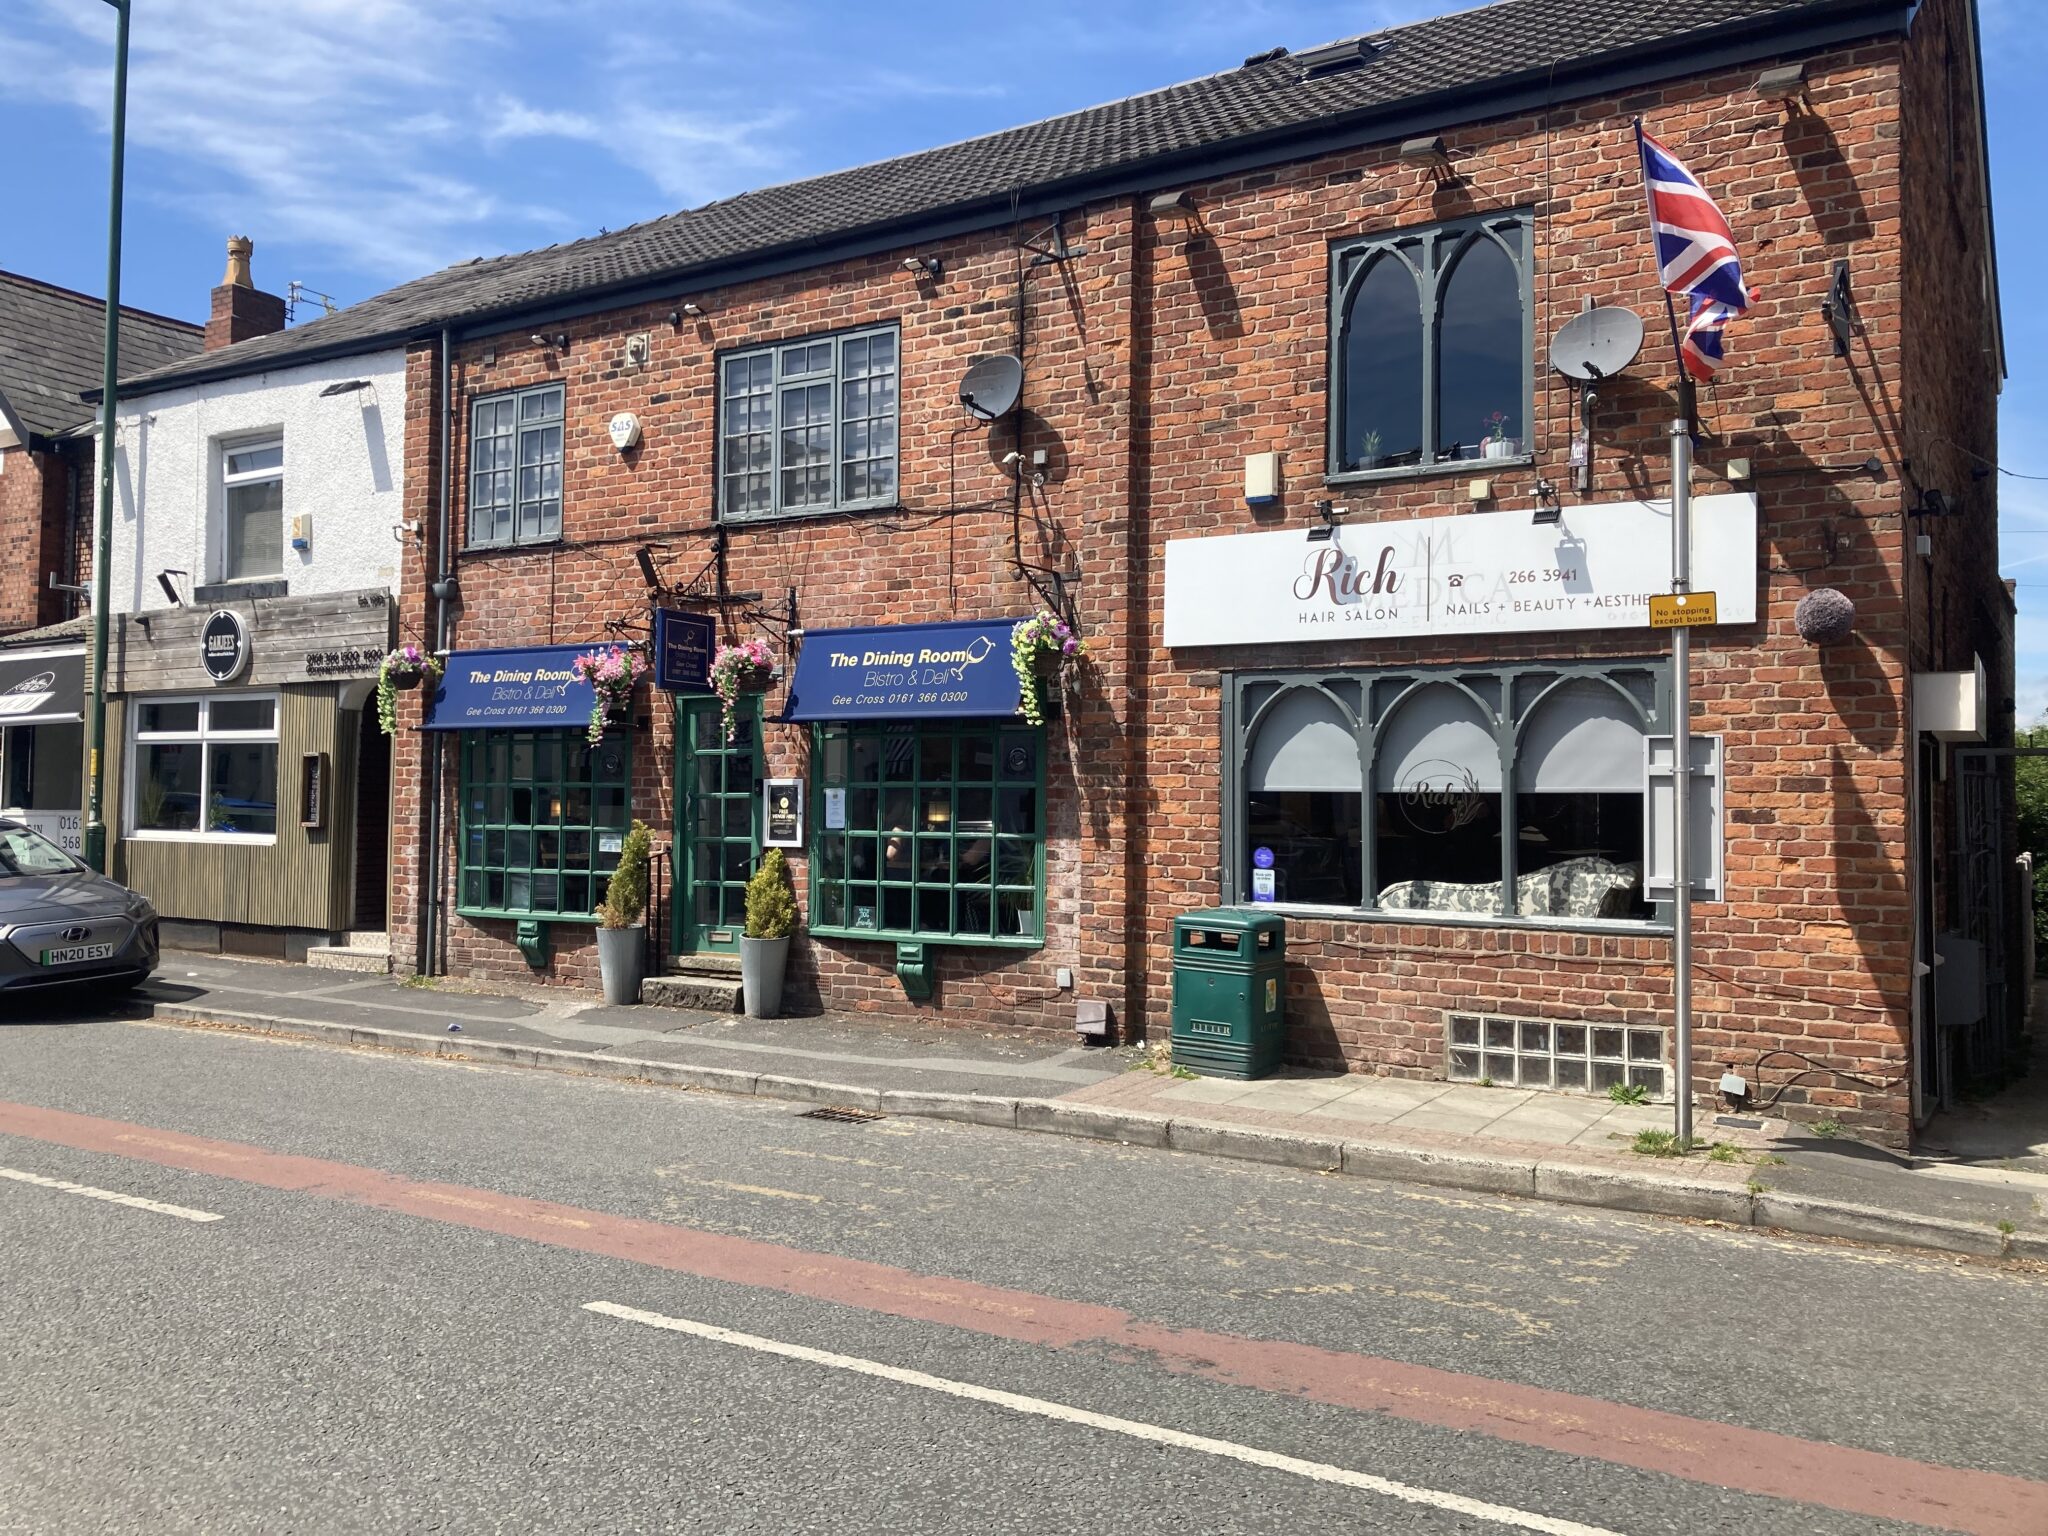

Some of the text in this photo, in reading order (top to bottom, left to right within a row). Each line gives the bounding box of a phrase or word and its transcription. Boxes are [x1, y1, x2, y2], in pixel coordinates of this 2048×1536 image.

[1293, 546, 1405, 605] Rich
[1508, 568, 1577, 584] 266 3941
[1446, 602, 1490, 616] NAILS
[1514, 598, 1577, 613] BEAUTY
[1673, 607, 1710, 616] stopping
[1299, 608, 1398, 624] HAIR SALON
[1654, 615, 1712, 625] except buses
[830, 649, 968, 668] The Dining Room
[469, 669, 570, 685] The Dining Room
[864, 669, 950, 687] Bistro & Deli
[491, 686, 556, 701] Bistro & Deli
[832, 691, 968, 705] Gee Cross 0161 366 0300
[466, 705, 567, 716] Gee Cross 0161 366 0300
[1406, 781, 1455, 809] Rich
[62, 836, 81, 849] 368
[52, 945, 111, 963] HN20 ESY
[1192, 1023, 1230, 1035] LITTER
